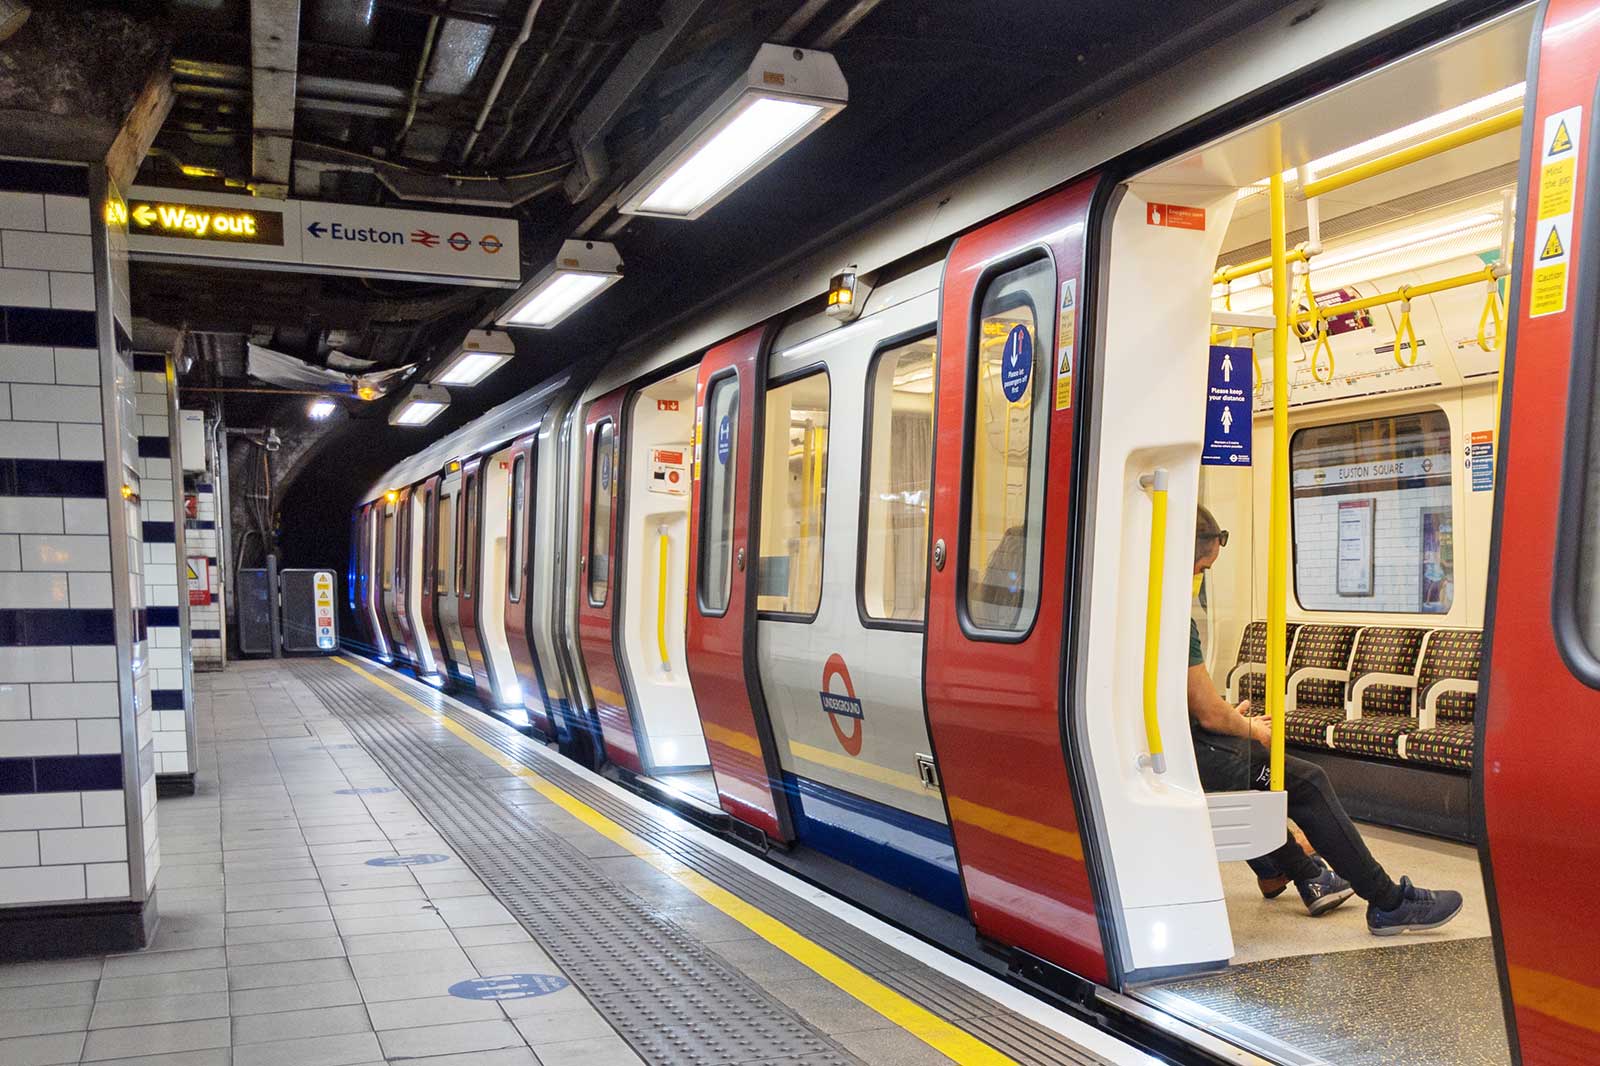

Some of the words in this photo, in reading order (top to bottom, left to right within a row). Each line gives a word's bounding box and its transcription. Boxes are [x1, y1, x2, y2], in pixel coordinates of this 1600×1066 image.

[158, 206, 210, 235] Way
[213, 213, 256, 234] out
[331, 223, 404, 245] Euston
[1229, 388, 1243, 396] keep
[1338, 465, 1369, 479] EUSTON
[1373, 463, 1404, 477] SQUARE
